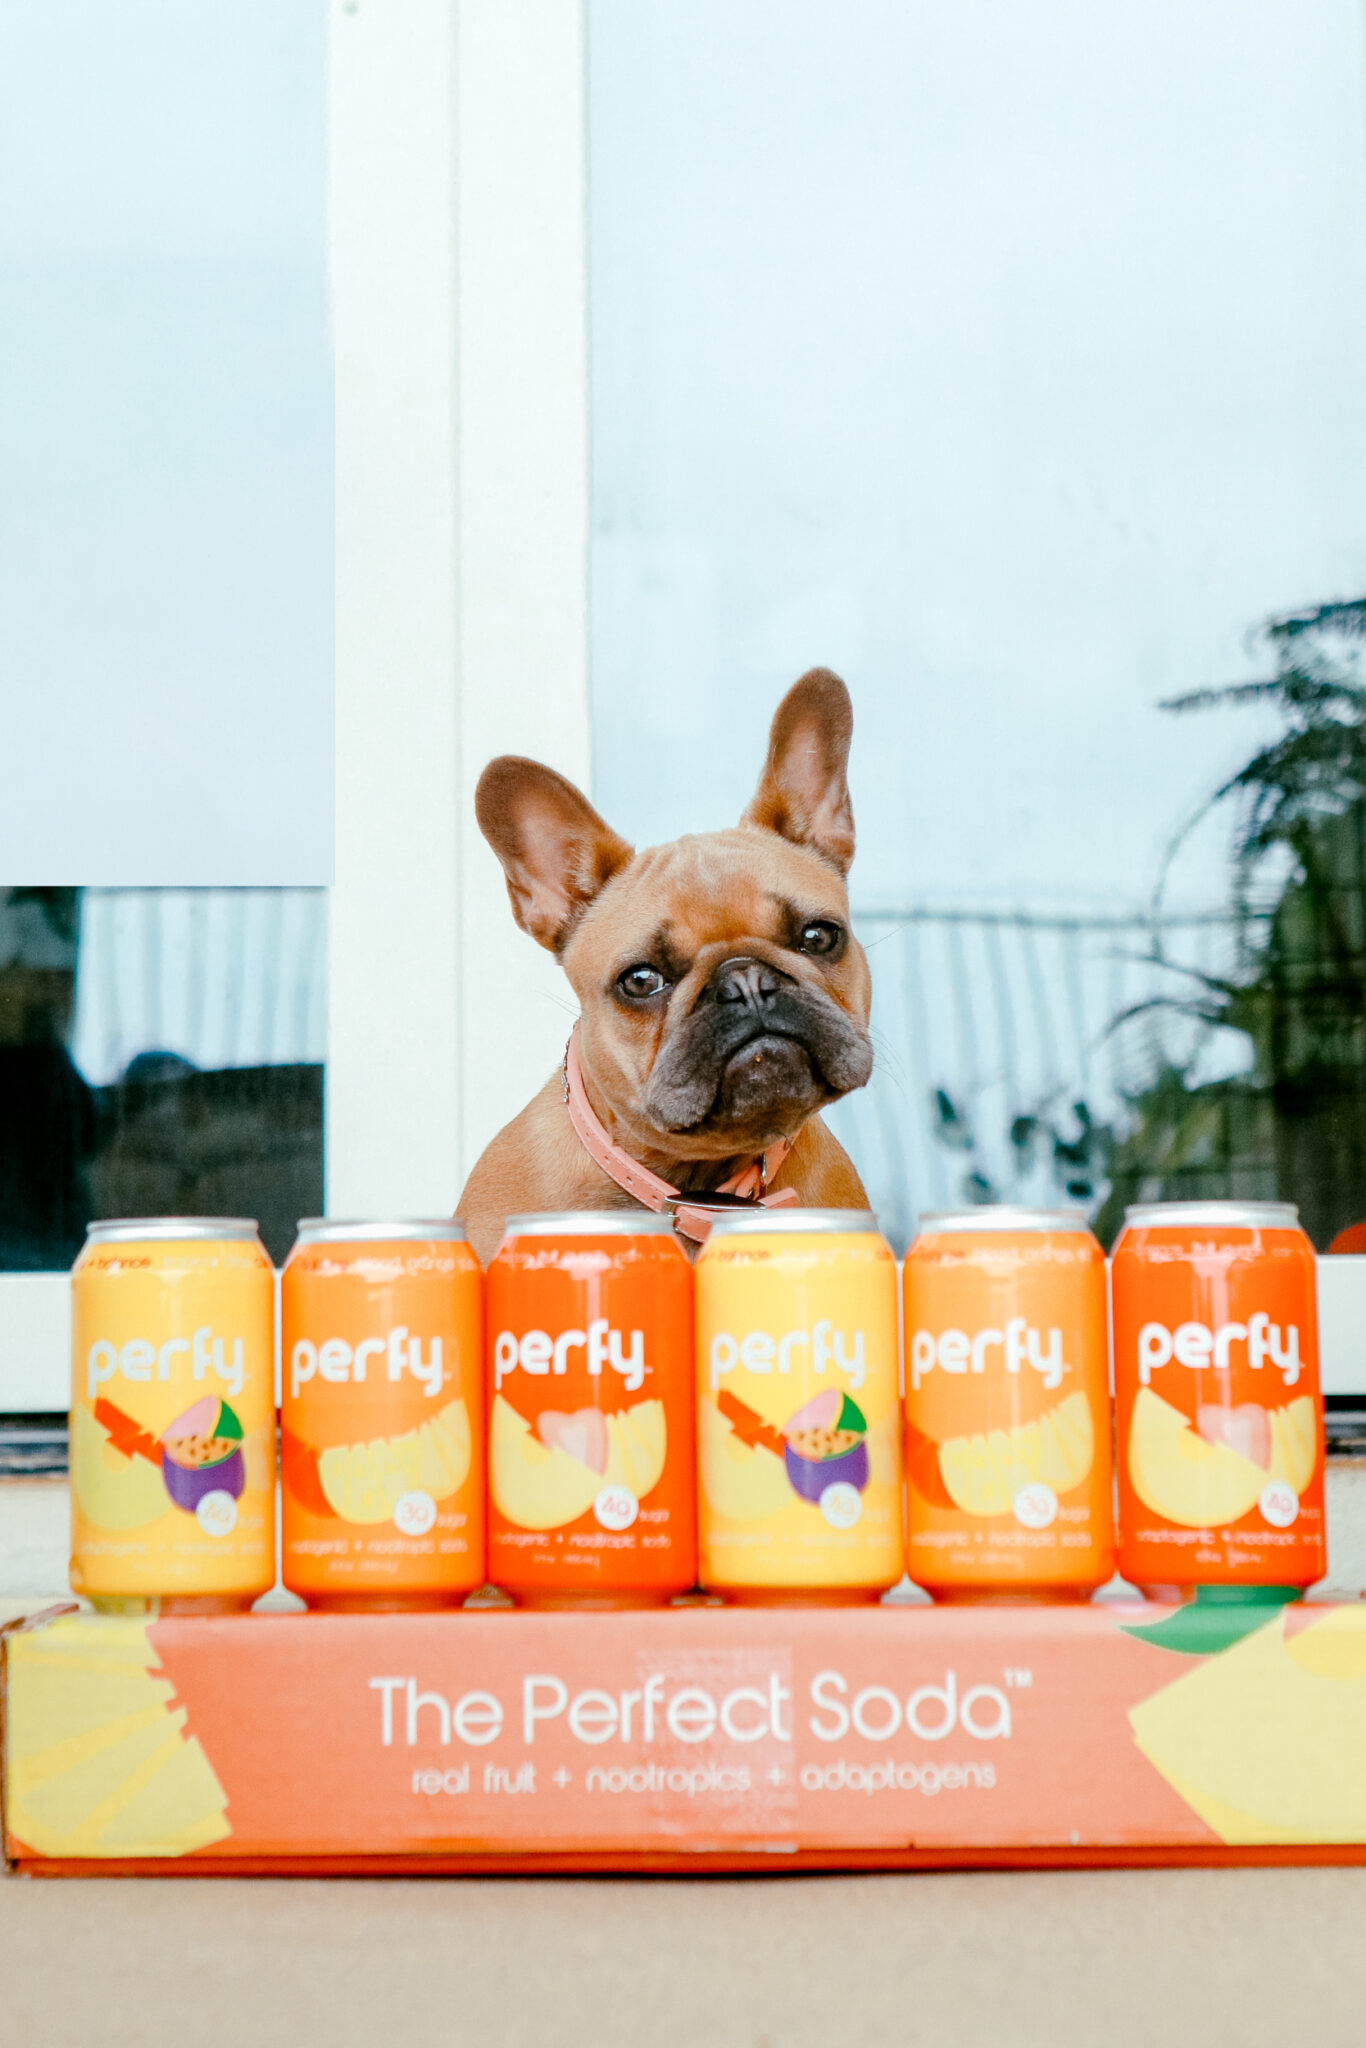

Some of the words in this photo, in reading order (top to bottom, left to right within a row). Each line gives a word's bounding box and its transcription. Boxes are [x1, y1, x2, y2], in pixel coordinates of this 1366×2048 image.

[87, 1325, 245, 1399] perfy
[291, 1326, 444, 1399] perfy
[494, 1318, 646, 1392] perfy
[709, 1319, 866, 1392] perfy
[911, 1317, 1064, 1391] perfy
[1137, 1312, 1301, 1386] perfy
[367, 1676, 504, 1747] The
[522, 1672, 793, 1745] Perfect
[411, 1763, 470, 1796] real
[482, 1761, 538, 1795] fruit
[585, 1759, 752, 1798] nootropics
[800, 1759, 998, 1797] adaptogens
